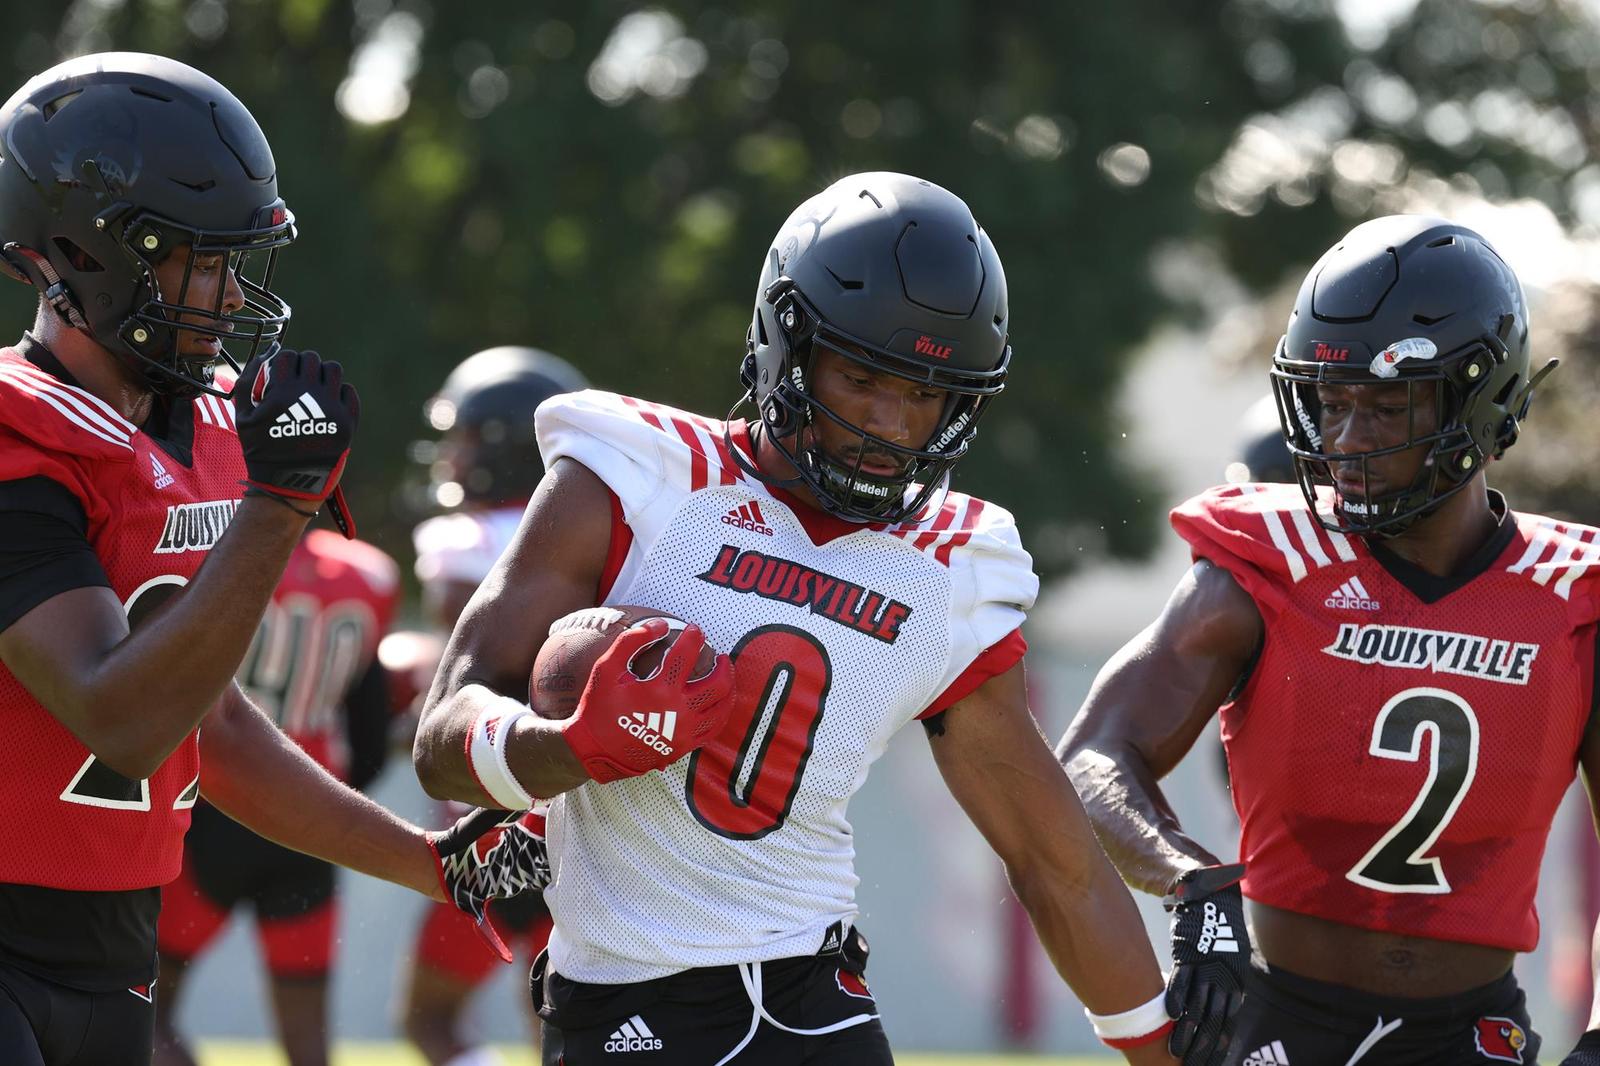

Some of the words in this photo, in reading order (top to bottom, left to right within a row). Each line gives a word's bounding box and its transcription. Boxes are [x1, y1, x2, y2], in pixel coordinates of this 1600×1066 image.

[915, 340, 953, 360] VILLE
[1315, 349, 1349, 361] VILLE
[269, 418, 338, 438] adidas
[928, 412, 970, 453] Riddell
[720, 515, 774, 537] adidas
[698, 544, 913, 645] LOUISVILLE
[1324, 596, 1381, 611] adidas
[1325, 623, 1540, 685] LOUISVILLE
[617, 715, 673, 756] adidas
[685, 623, 833, 841] 0
[1345, 686, 1480, 894] 2
[1197, 901, 1219, 954] adidas
[604, 1036, 664, 1053] adidas
